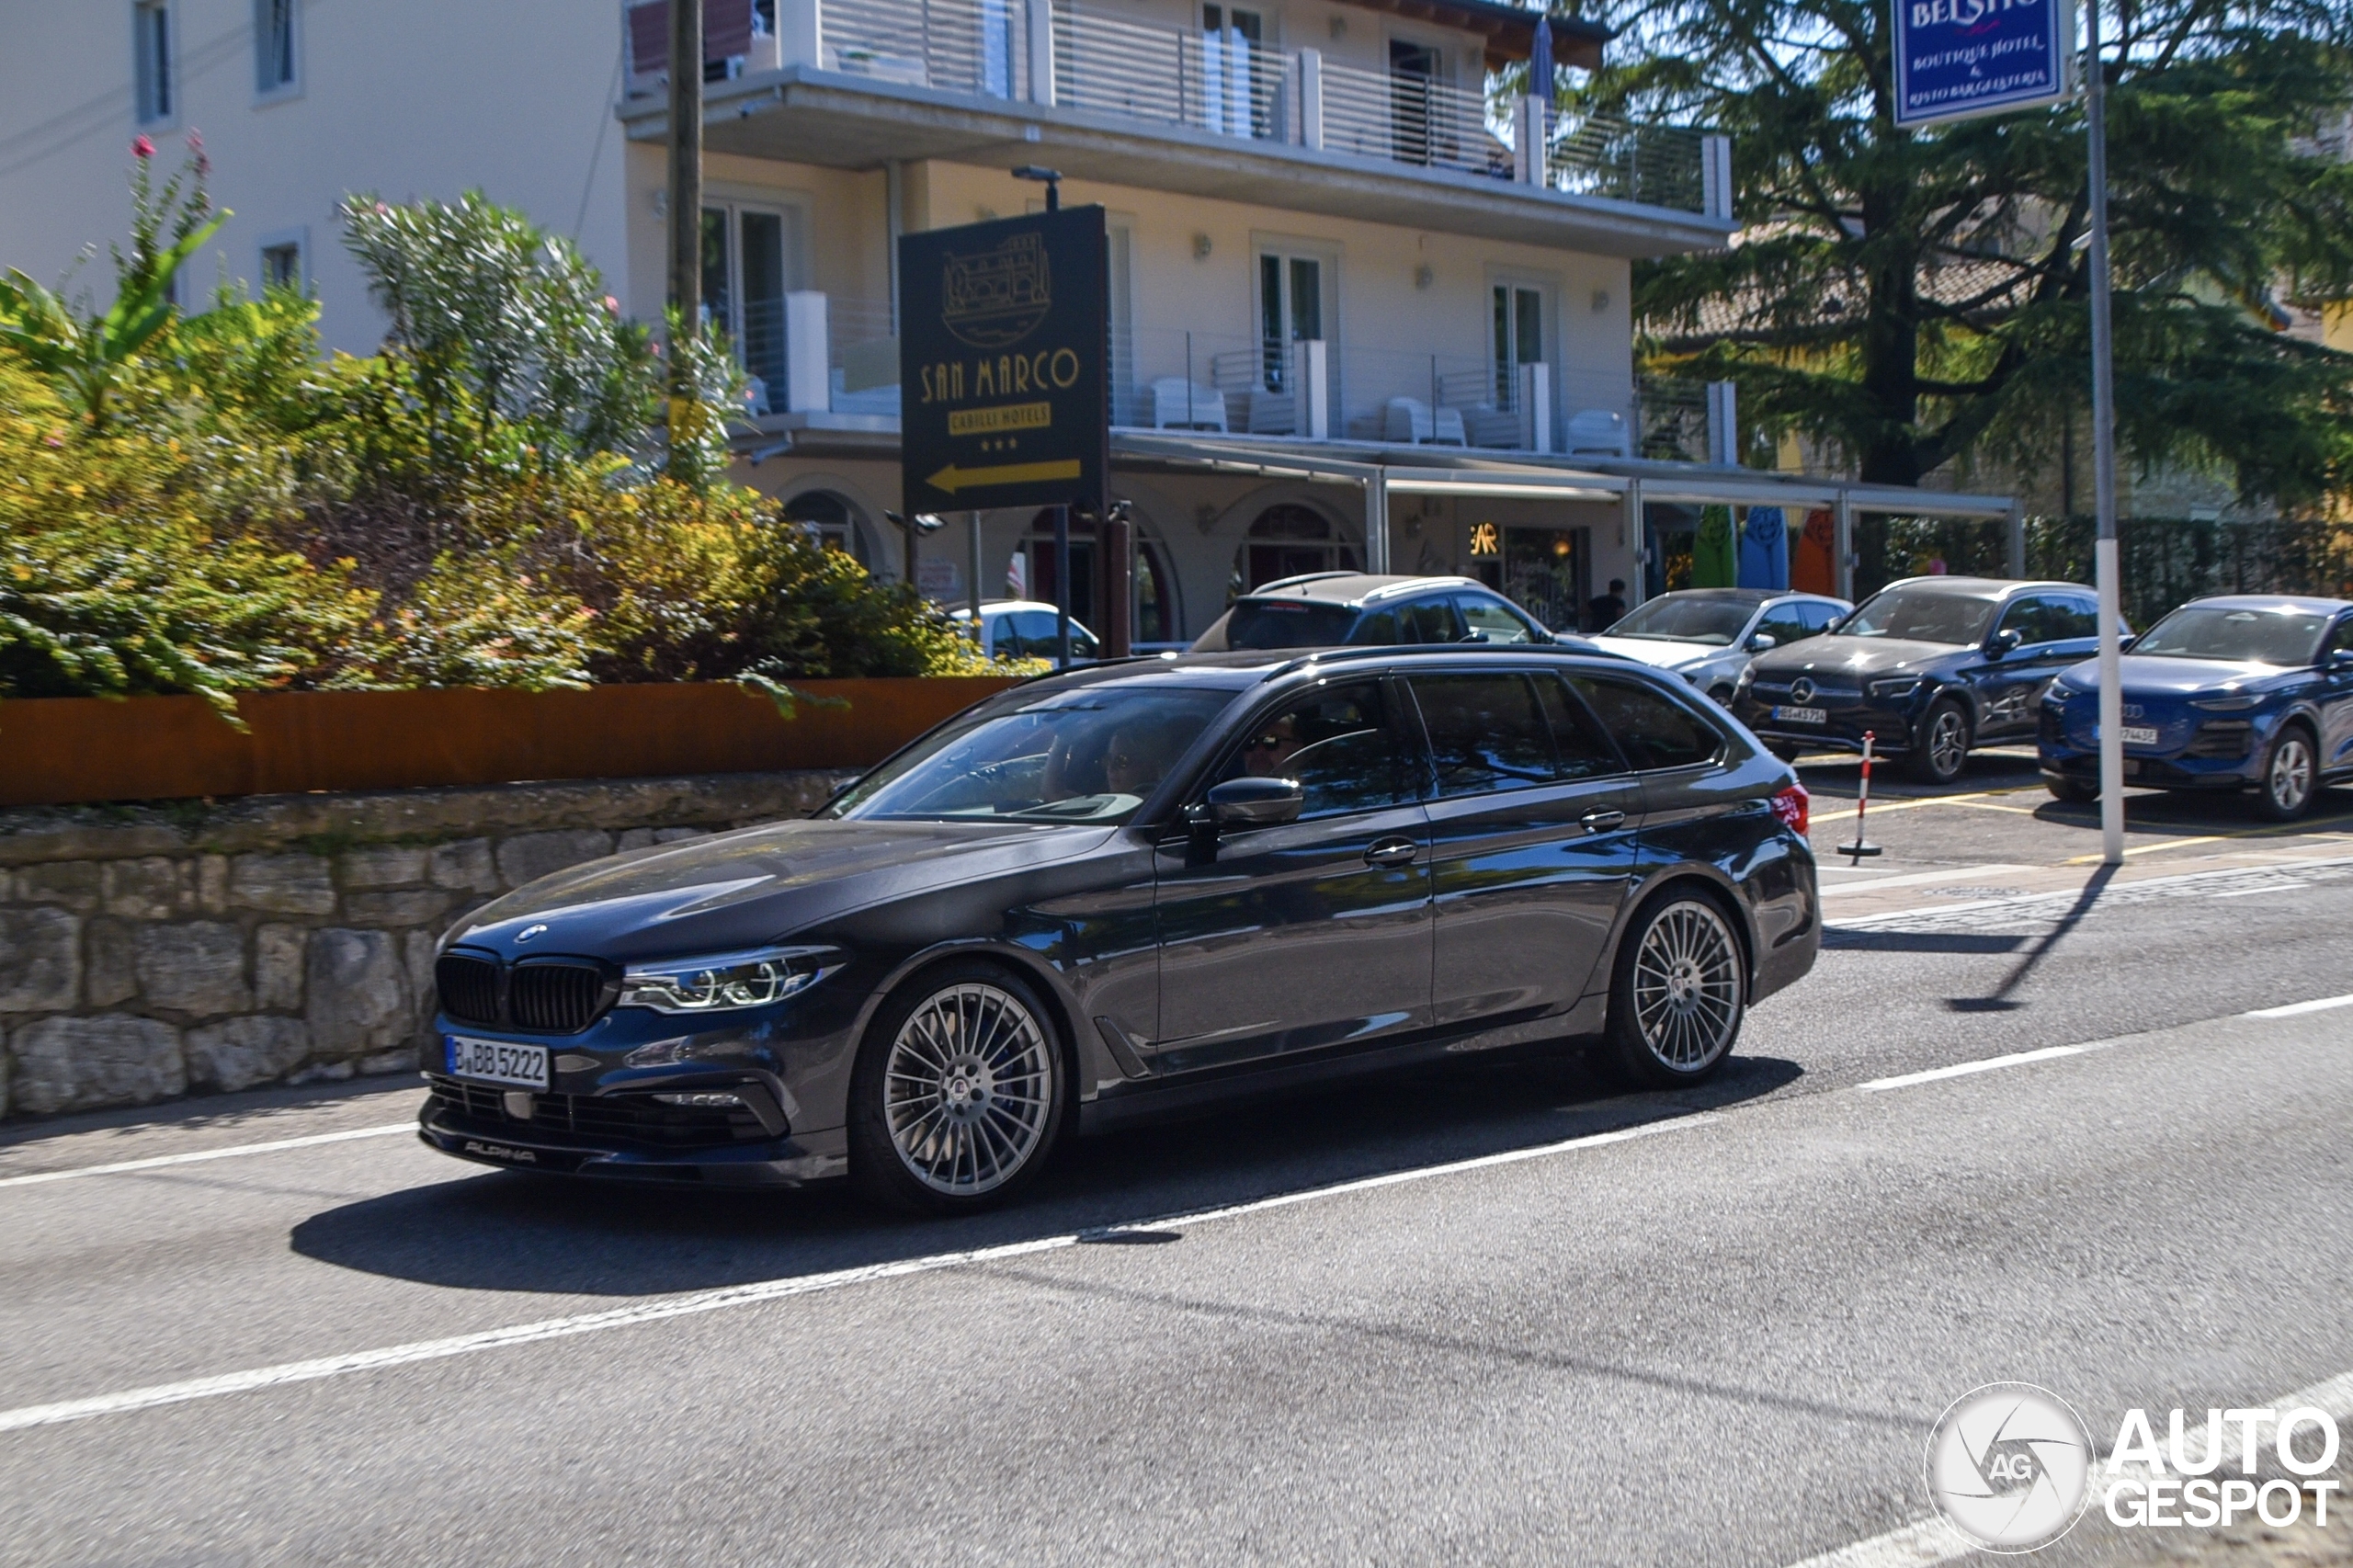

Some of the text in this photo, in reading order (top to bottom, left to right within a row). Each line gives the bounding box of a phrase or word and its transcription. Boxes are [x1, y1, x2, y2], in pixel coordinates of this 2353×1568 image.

[1913, 33, 2046, 72] BOUTIQUE HOTEL
[920, 347, 1079, 403] SAN MARCO
[1002, 404, 1049, 425] HOTELS
[498, 1047, 544, 1082] 5222
[465, 1141, 536, 1163] ALPINA
